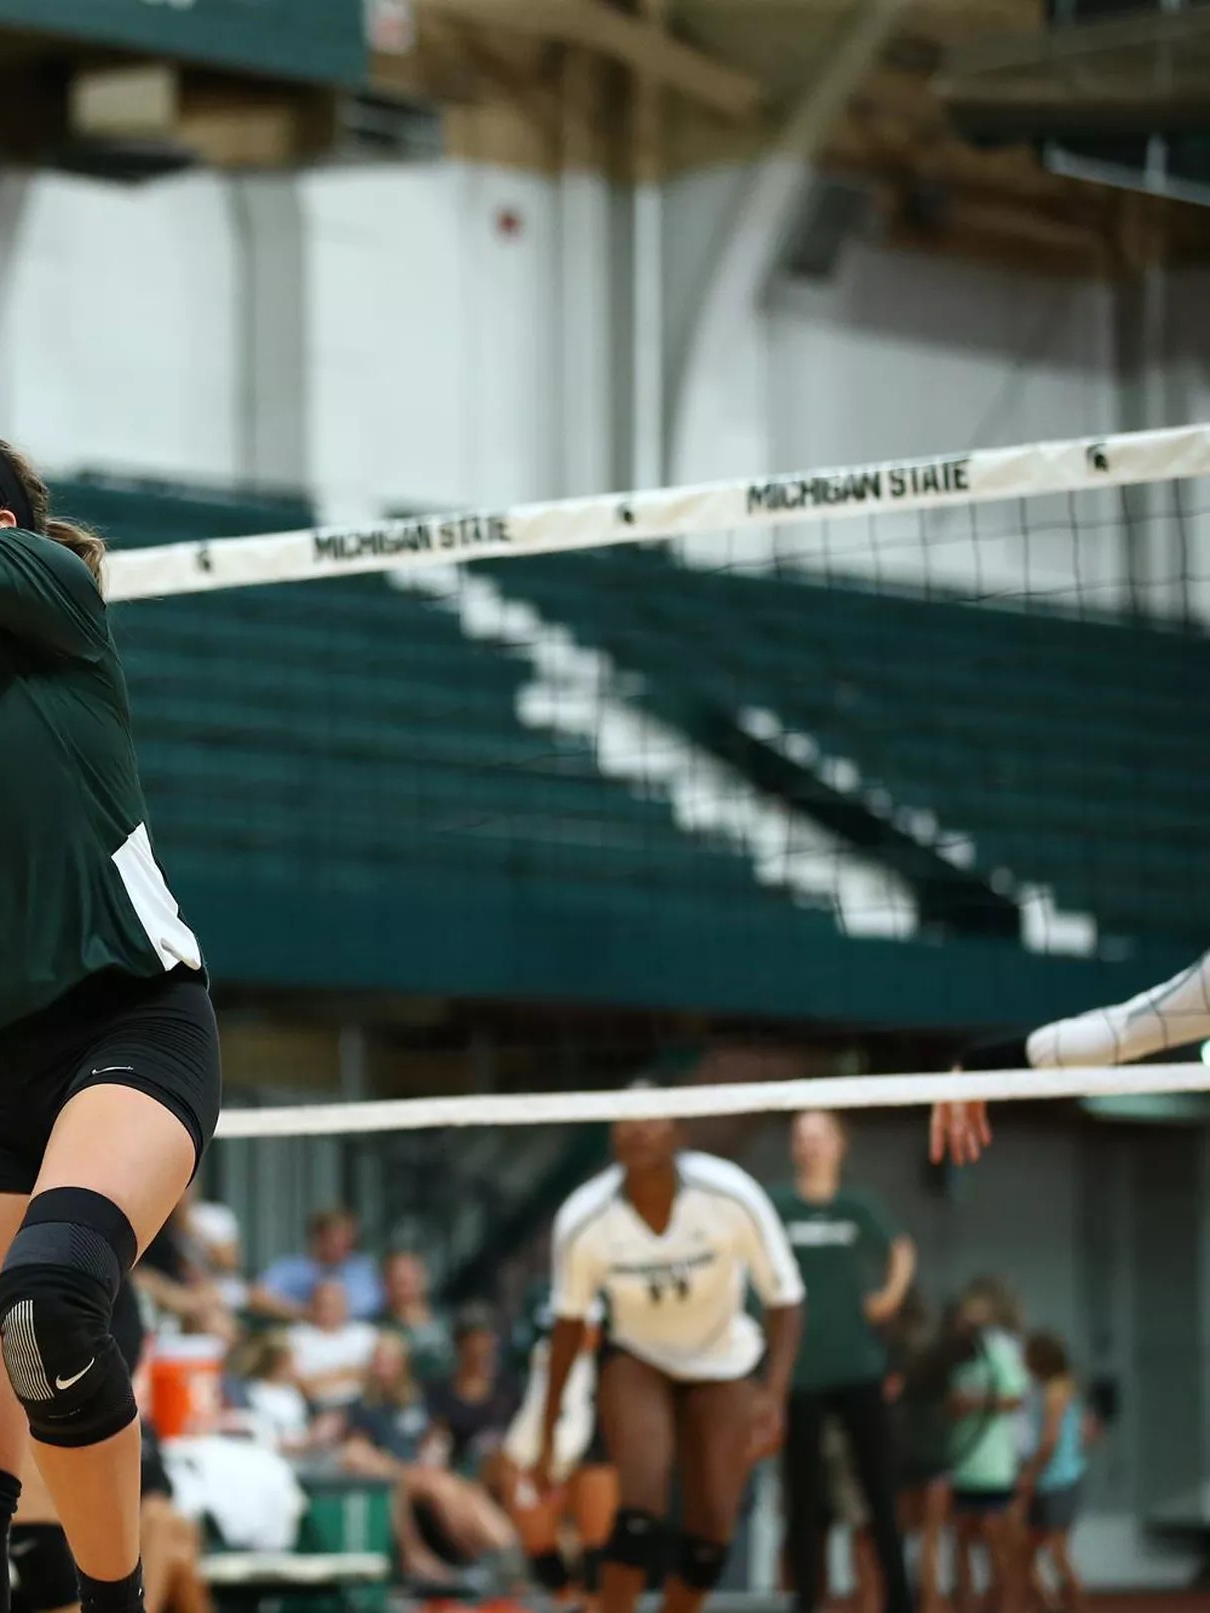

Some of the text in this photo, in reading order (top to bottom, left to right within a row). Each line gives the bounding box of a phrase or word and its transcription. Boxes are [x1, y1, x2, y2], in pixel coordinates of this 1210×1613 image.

[746, 457, 970, 515] MICHIGAN STATE
[314, 514, 512, 564] MICHIGAN STATE
